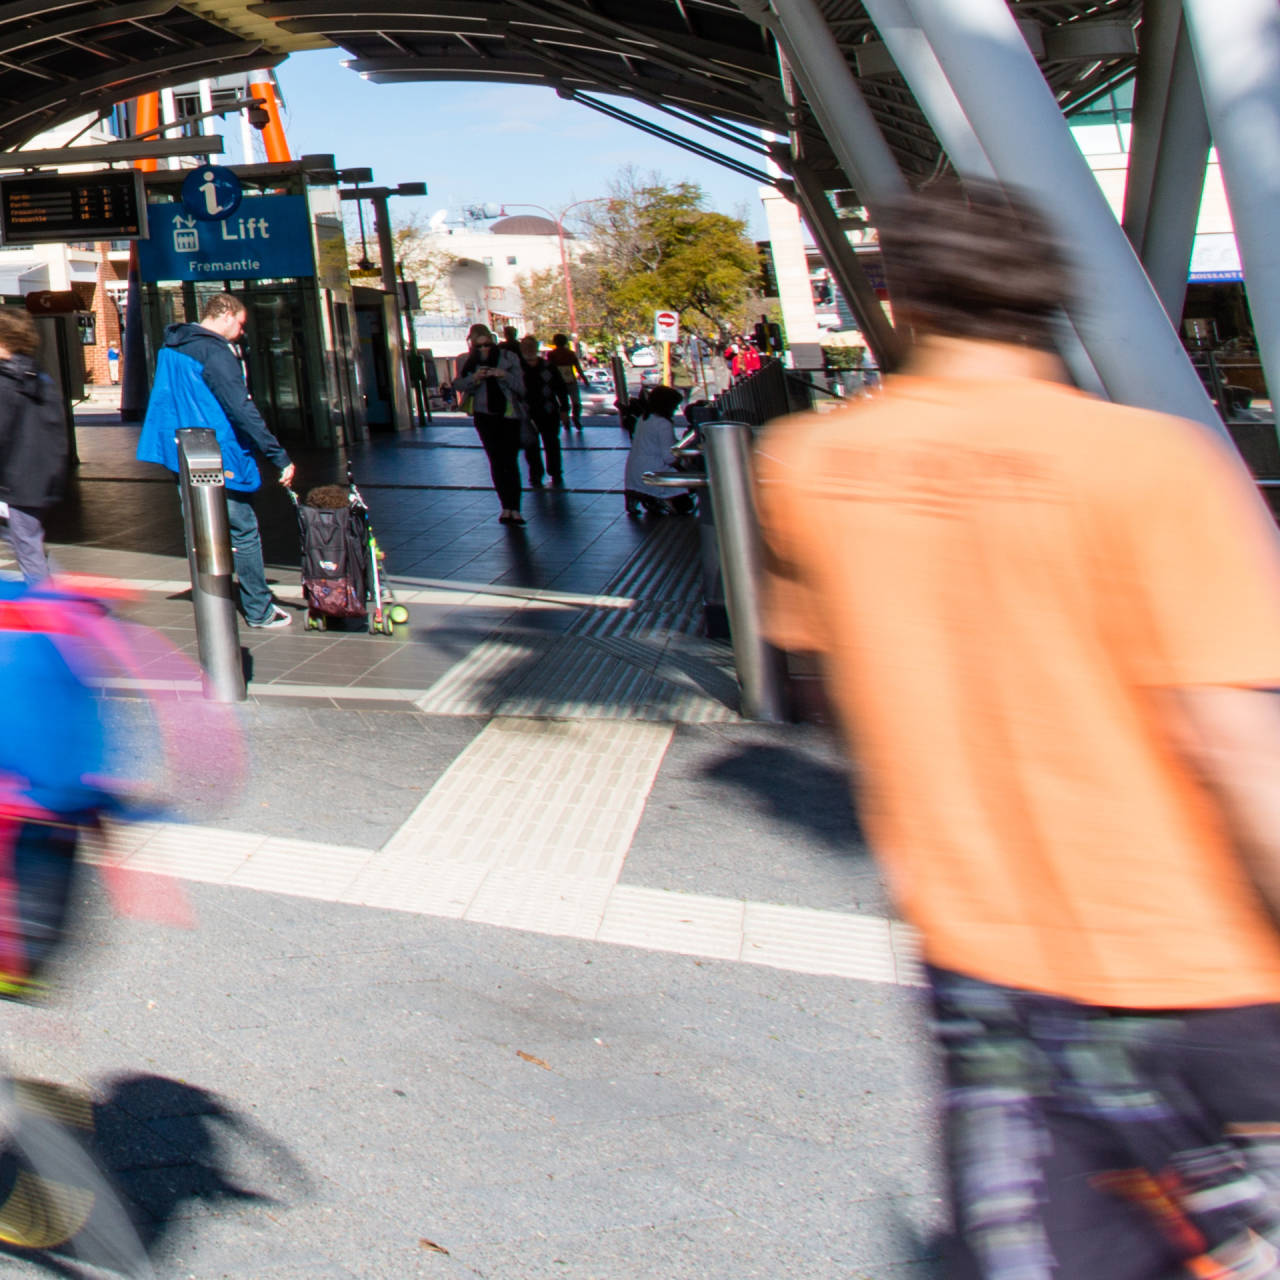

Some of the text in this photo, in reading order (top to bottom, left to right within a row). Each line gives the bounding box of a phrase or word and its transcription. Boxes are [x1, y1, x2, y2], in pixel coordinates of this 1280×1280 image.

[220, 217, 270, 241] Lift
[189, 259, 261, 272] Fremantle
[1189, 271, 1237, 279] ROISSANT
